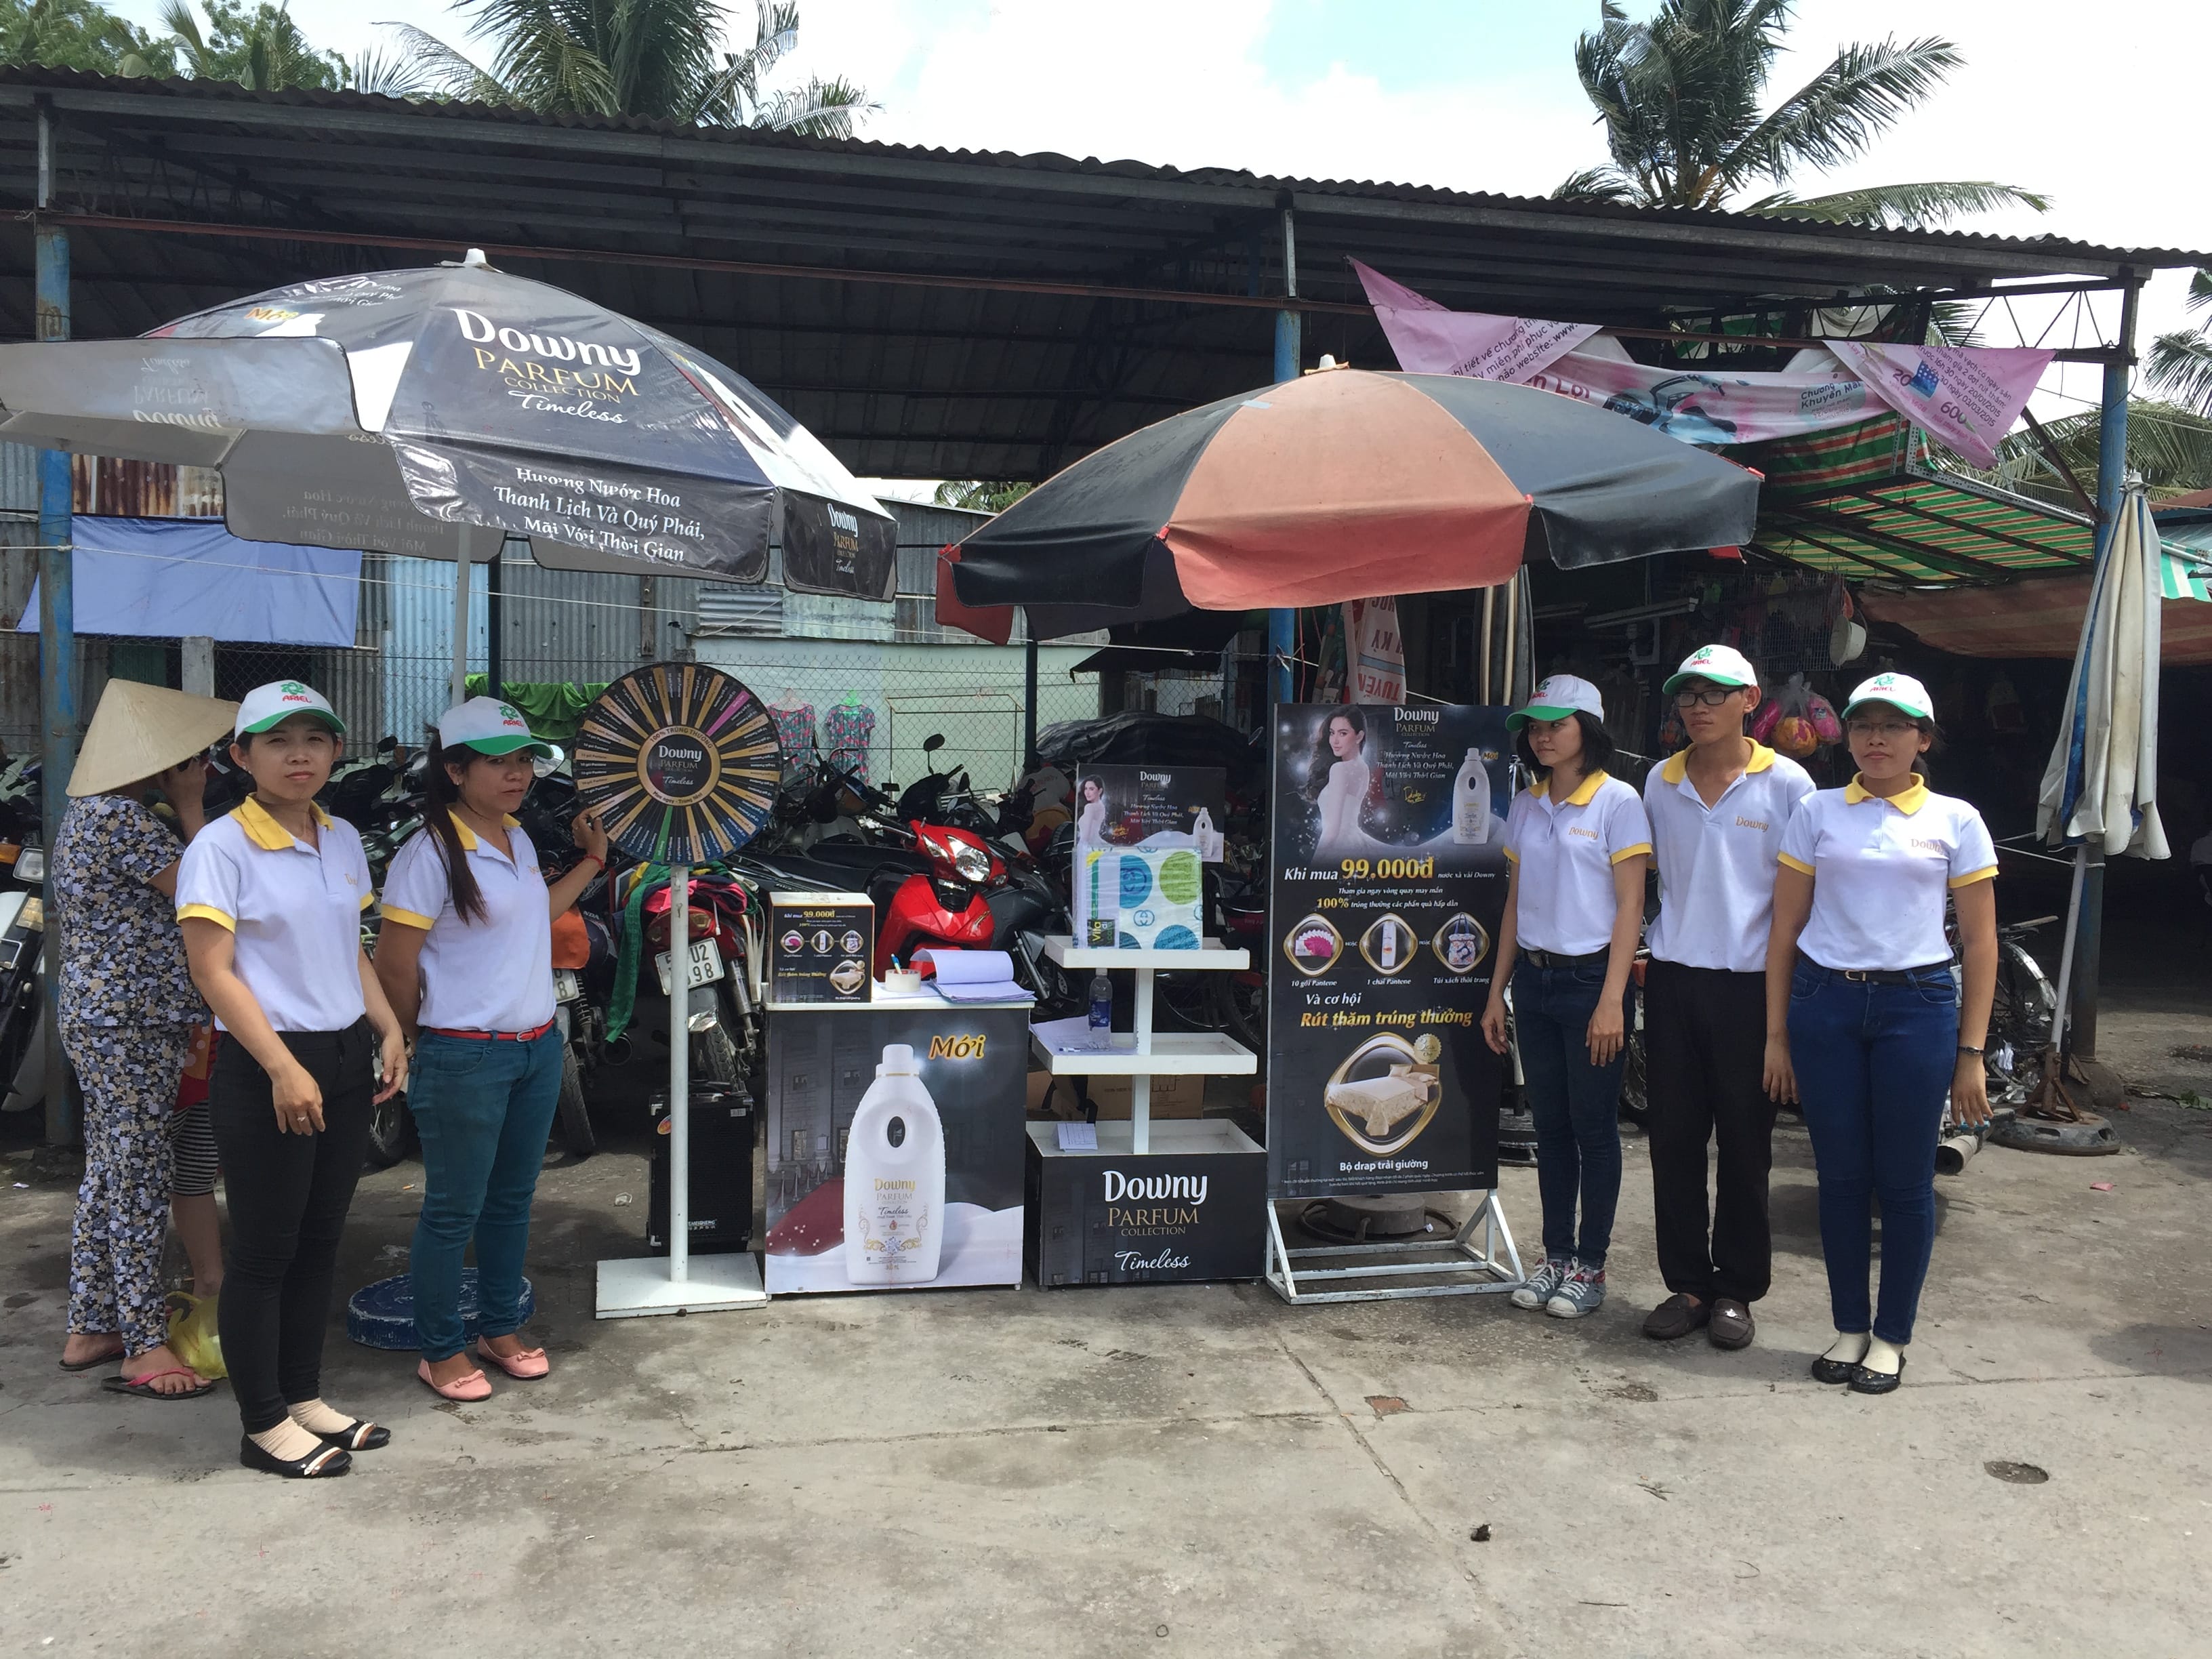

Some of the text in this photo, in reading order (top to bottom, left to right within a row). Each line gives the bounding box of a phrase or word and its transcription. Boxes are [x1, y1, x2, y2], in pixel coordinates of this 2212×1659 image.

[450, 308, 641, 376] Downy
[1516, 339, 1555, 369] website:
[472, 347, 641, 396] PARFUM
[1962, 368, 1969, 376] 2
[504, 377, 621, 404] COLLECTION
[1935, 357, 1946, 370] 16h
[1944, 367, 1954, 377] 30
[1968, 387, 2001, 417] 20/01/2015
[508, 390, 628, 424] Timeless
[1962, 395, 1996, 427] 03/03/2015
[515, 467, 681, 508] Hương Nước Hoa
[493, 486, 705, 541] Thanh Lịch Và Quý Phái,
[827, 503, 858, 538] Downy
[523, 516, 685, 562] Mãi Với Thời Gian
[283, 695, 312, 703] ARIEL
[502, 719, 525, 727] ARIEL
[1394, 707, 1439, 724] Downy
[1396, 723, 1435, 733] PARFUM
[658, 745, 702, 762] Downy
[661, 759, 698, 769] PARFUM
[1140, 771, 1171, 783] Downy
[1568, 827, 1599, 840] Downy
[1735, 816, 1769, 833] Downy
[1910, 838, 1944, 855] Down
[1284, 867, 1307, 880] Khi
[1310, 870, 1338, 880] mua
[1340, 857, 1434, 880] 99.000đ
[1474, 871, 1496, 880] Downy
[1316, 897, 1349, 908] 100%
[1351, 900, 1368, 909] trúng
[1306, 992, 1362, 1006] Và cơ hội
[1300, 1007, 1473, 1029] Rút thăm trúng thưởng
[927, 1034, 986, 1060] Mới
[1339, 1159, 1429, 1172] Bộ drap trải giường
[874, 1178, 916, 1191] Downy
[1102, 1170, 1208, 1206] Downy
[878, 1206, 909, 1215] Timeless
[1108, 1207, 1200, 1227] PARFUM
[1121, 1226, 1187, 1237] COLLECTION
[1114, 1248, 1191, 1271] Timeless
